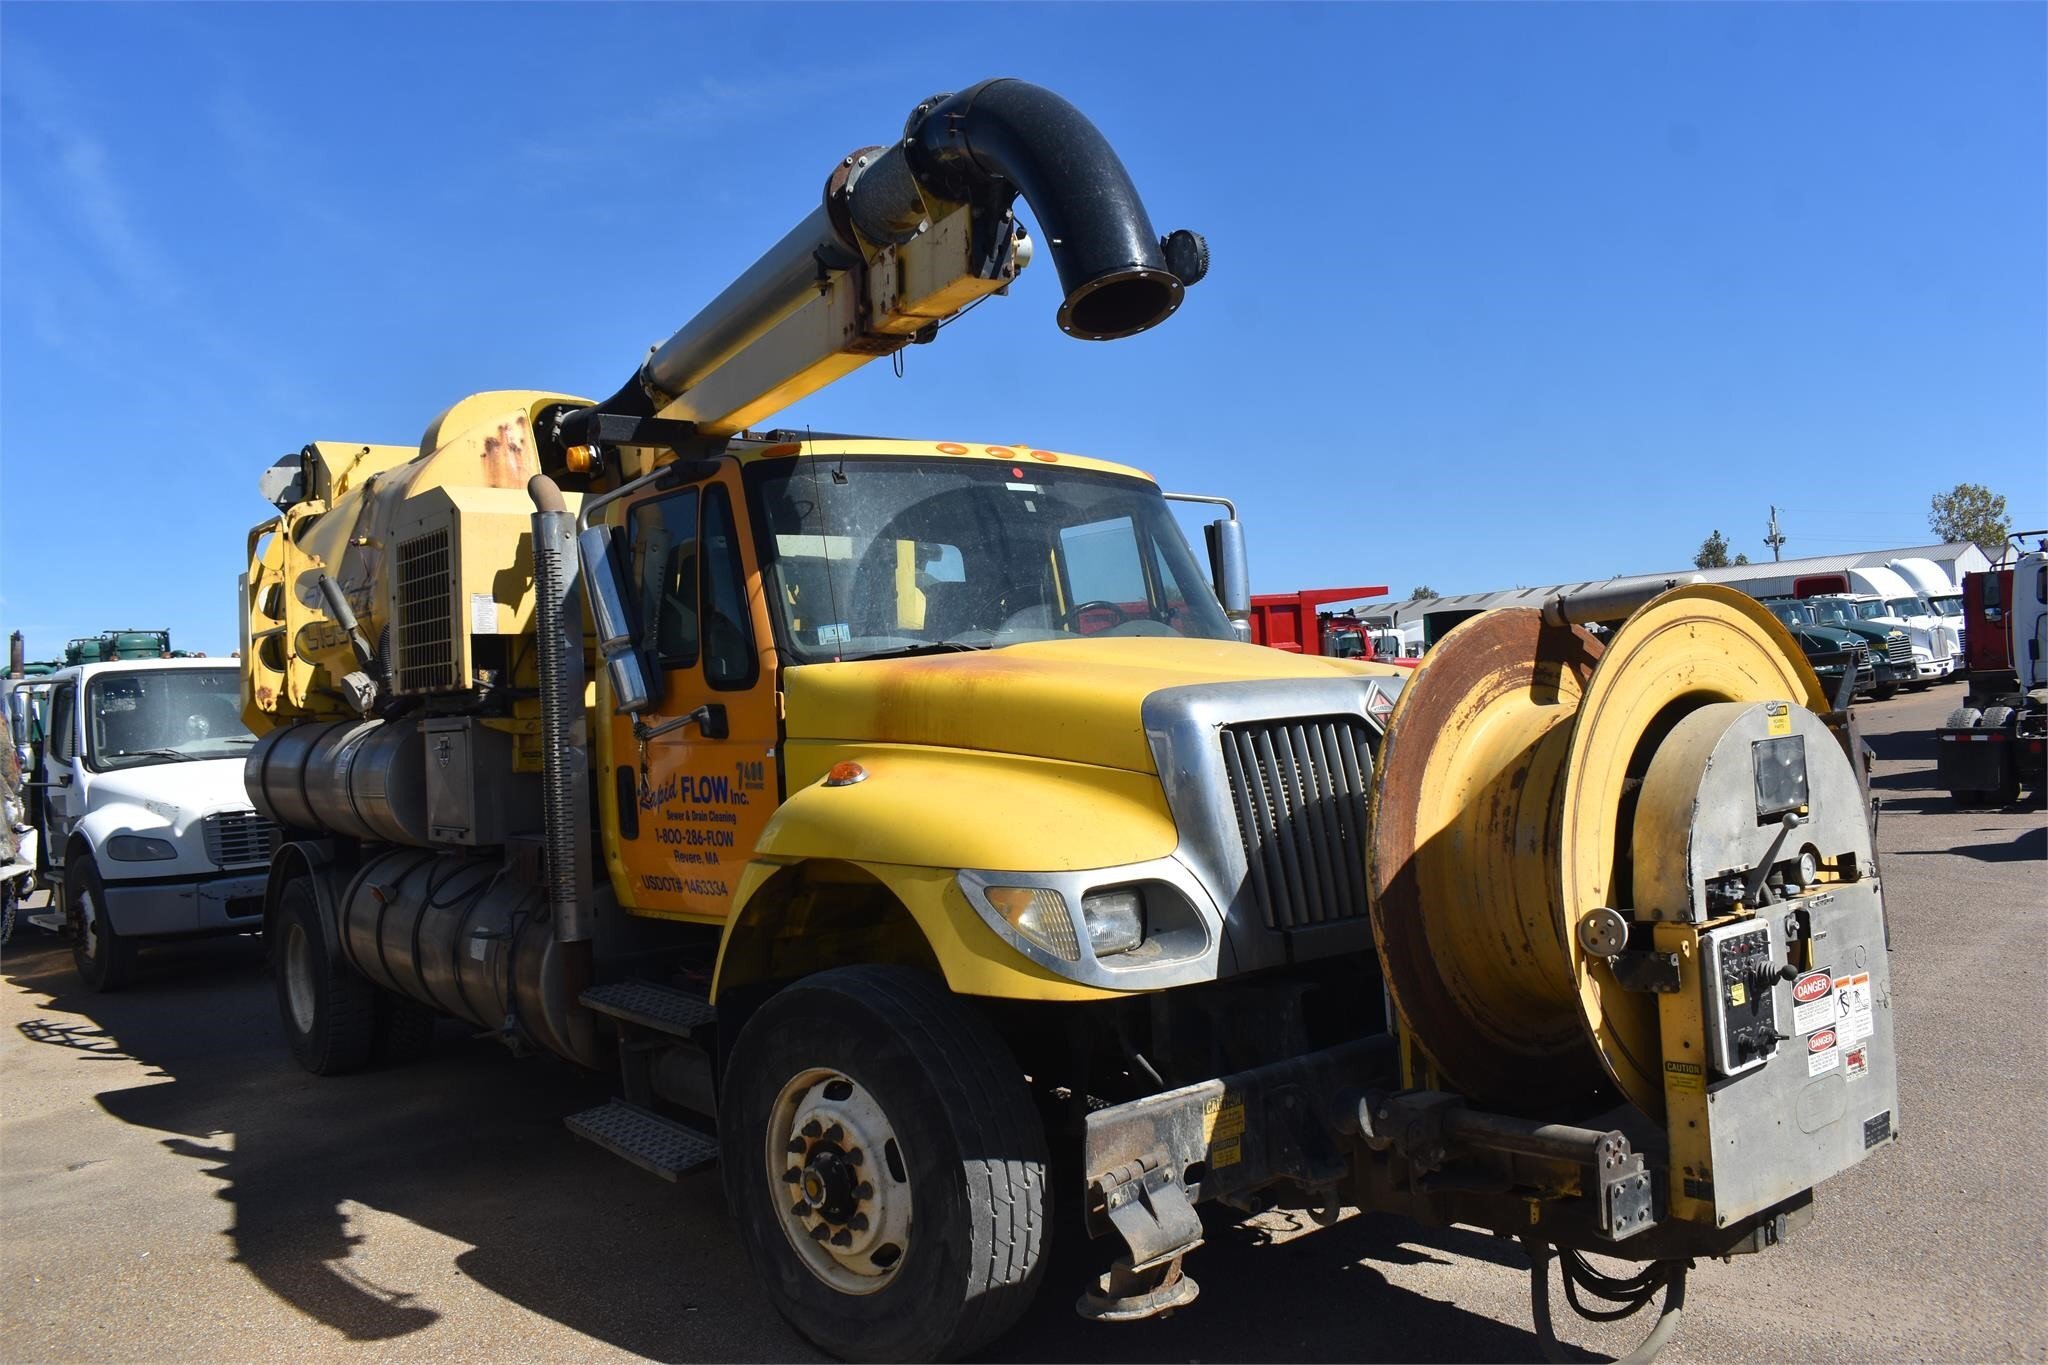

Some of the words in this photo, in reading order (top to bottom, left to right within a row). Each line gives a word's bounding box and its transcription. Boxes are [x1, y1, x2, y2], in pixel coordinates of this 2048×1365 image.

[681, 776, 728, 804] FLOW
[731, 790, 749, 805] Inc.
[666, 810, 685, 821] Sewer
[686, 811, 691, 821] &
[692, 811, 708, 822] Drain
[709, 811, 737, 825] Cleaning
[655, 828, 734, 847] 1-800-286-FLOW
[706, 852, 719, 865] MA
[641, 875, 683, 893] USDOT#
[685, 880, 728, 896] 1463334
[1797, 978, 1828, 998] DANGER
[1810, 1033, 1833, 1049] DANGER
[1667, 1062, 1700, 1074] CAUTION
